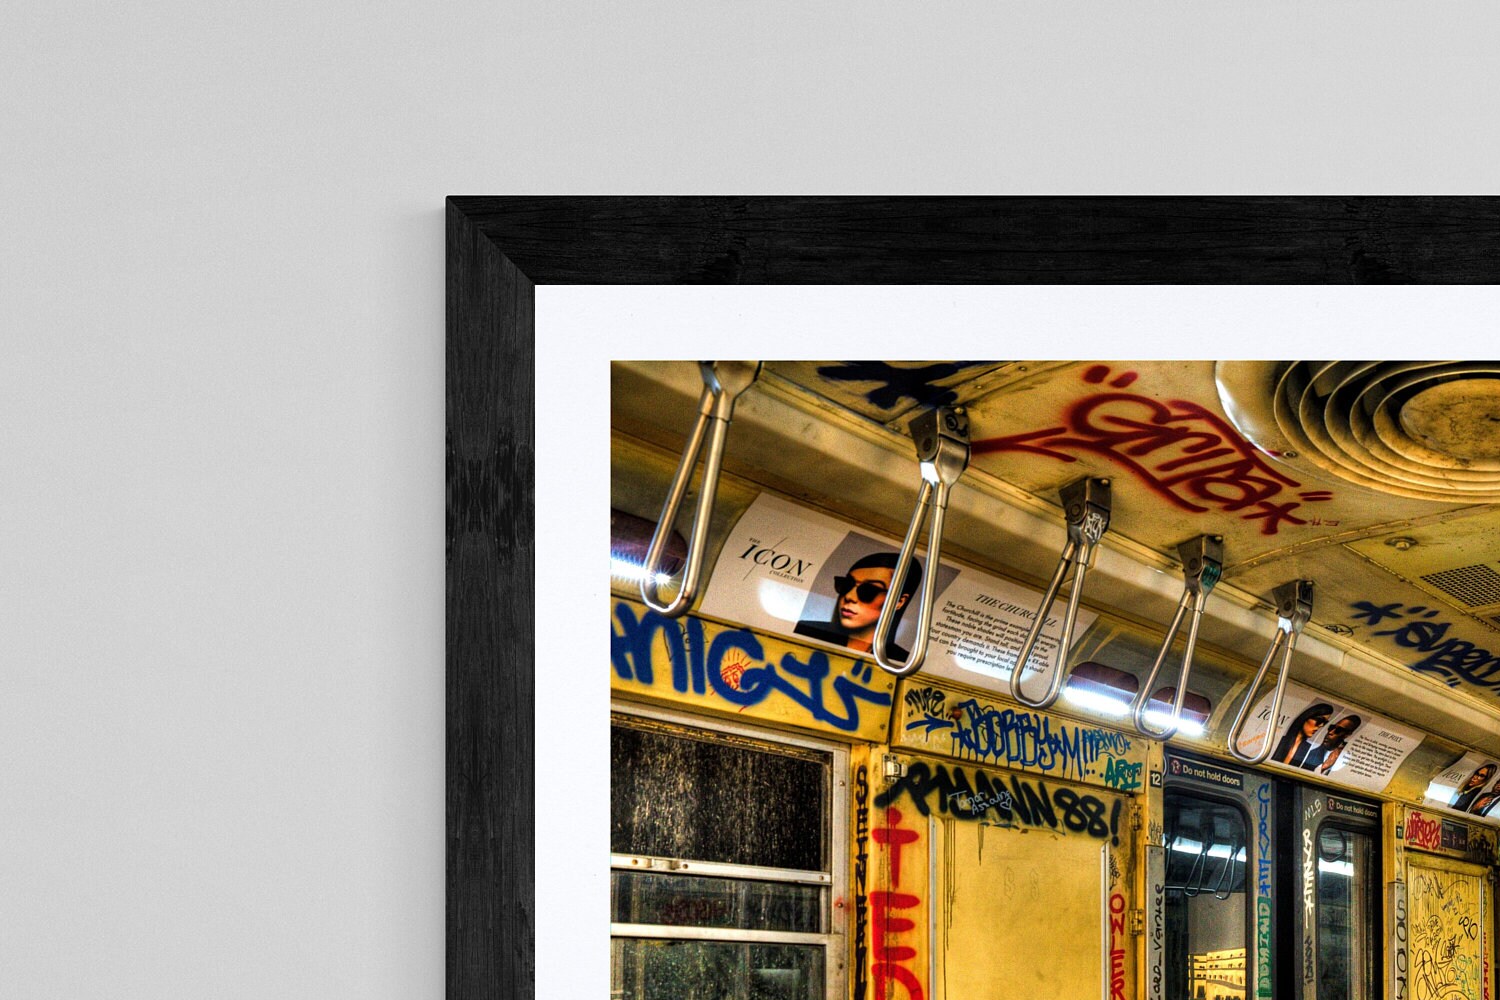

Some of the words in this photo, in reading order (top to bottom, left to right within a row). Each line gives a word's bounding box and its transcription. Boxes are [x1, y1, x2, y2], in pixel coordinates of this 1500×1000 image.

[739, 544, 812, 576] ICON
[769, 570, 804, 583] COLLECTION
[957, 605, 982, 616] Churchill
[975, 594, 1002, 608] THE
[997, 602, 1061, 628] CHURCLL
[1151, 773, 1161, 786] 12
[1183, 765, 1192, 775] Do
[1194, 769, 1206, 779] not
[1207, 770, 1221, 782] hold
[1222, 775, 1240, 786] doors
[1336, 802, 1343, 810] Do
[1353, 806, 1364, 814] hold
[1364, 809, 1378, 818] doors
